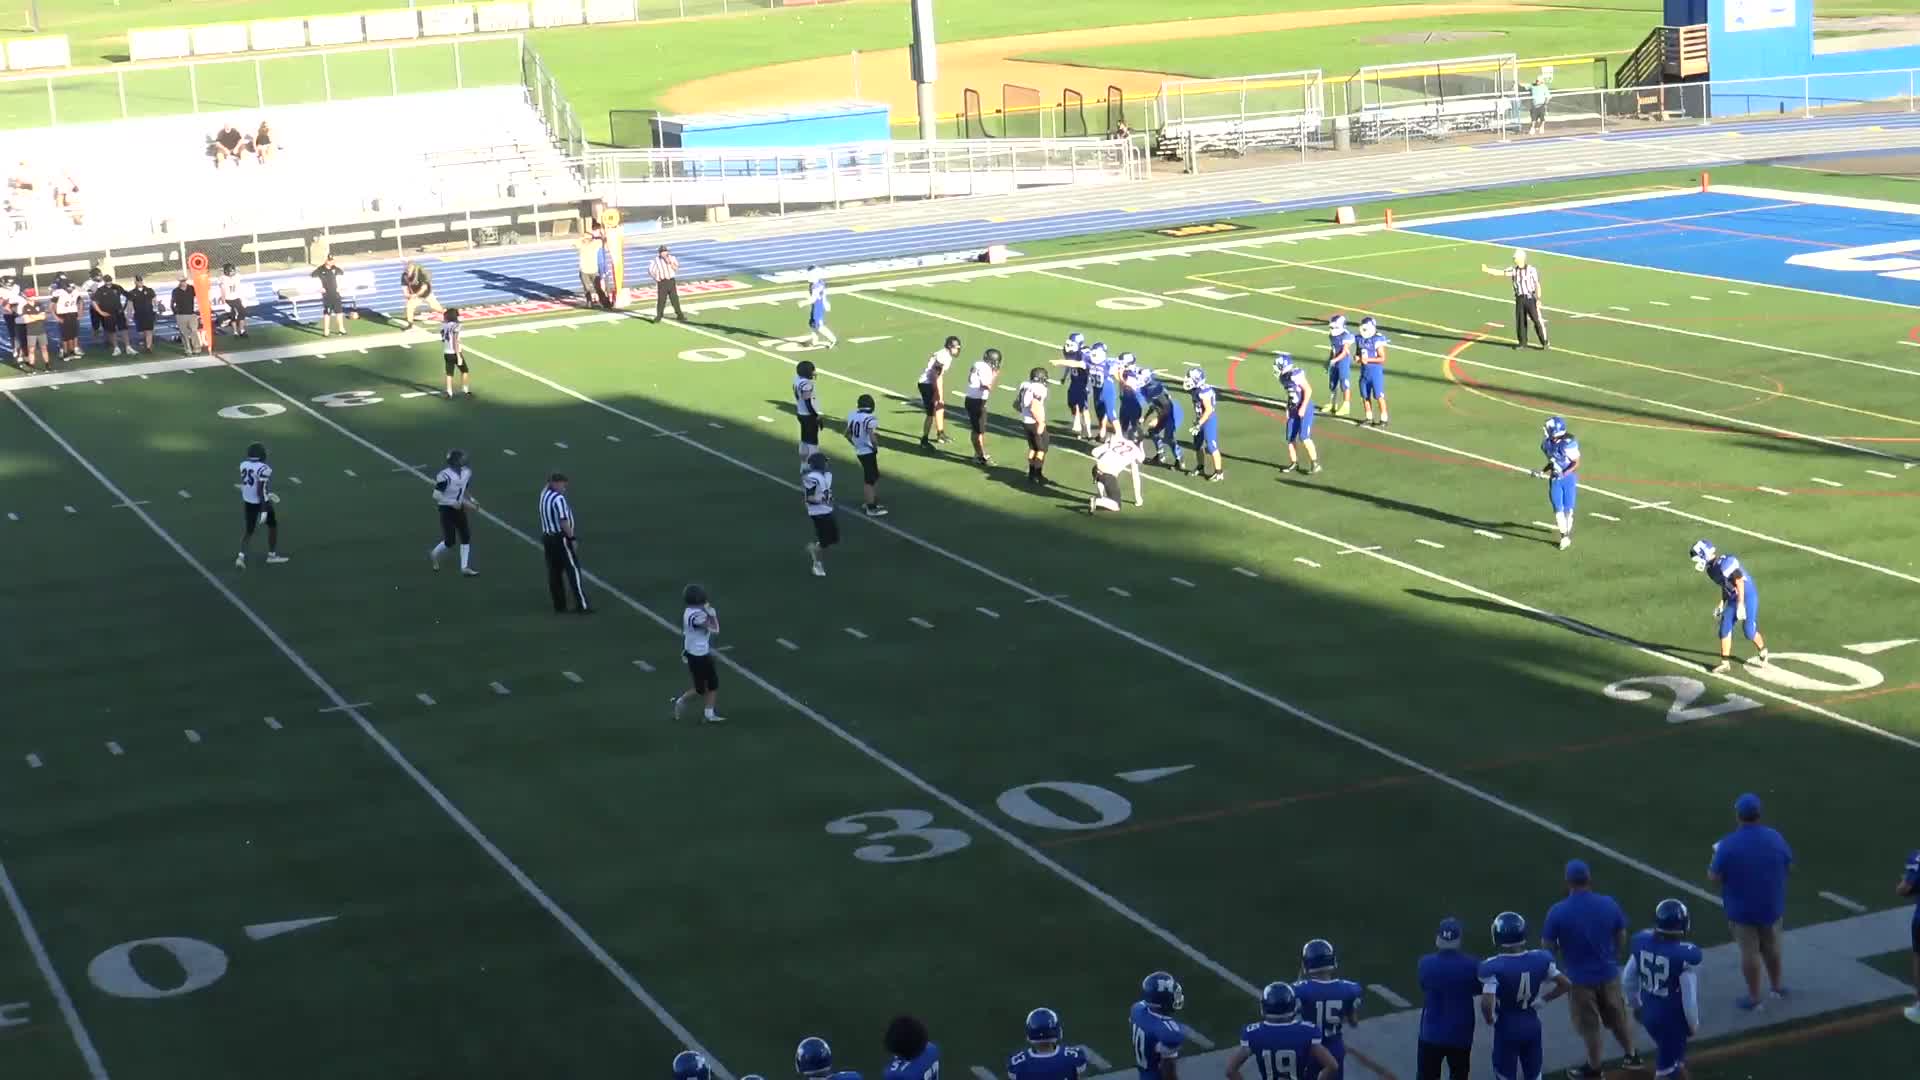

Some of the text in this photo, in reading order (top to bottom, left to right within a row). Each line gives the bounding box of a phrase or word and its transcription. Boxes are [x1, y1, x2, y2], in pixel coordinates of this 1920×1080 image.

[241, 468, 255, 487] 25
[824, 780, 1133, 864] 30
[1516, 971, 1533, 1010] 4
[1639, 949, 1670, 997] 52
[1315, 999, 1343, 1037] 15
[1261, 1049, 1298, 1080] 19
